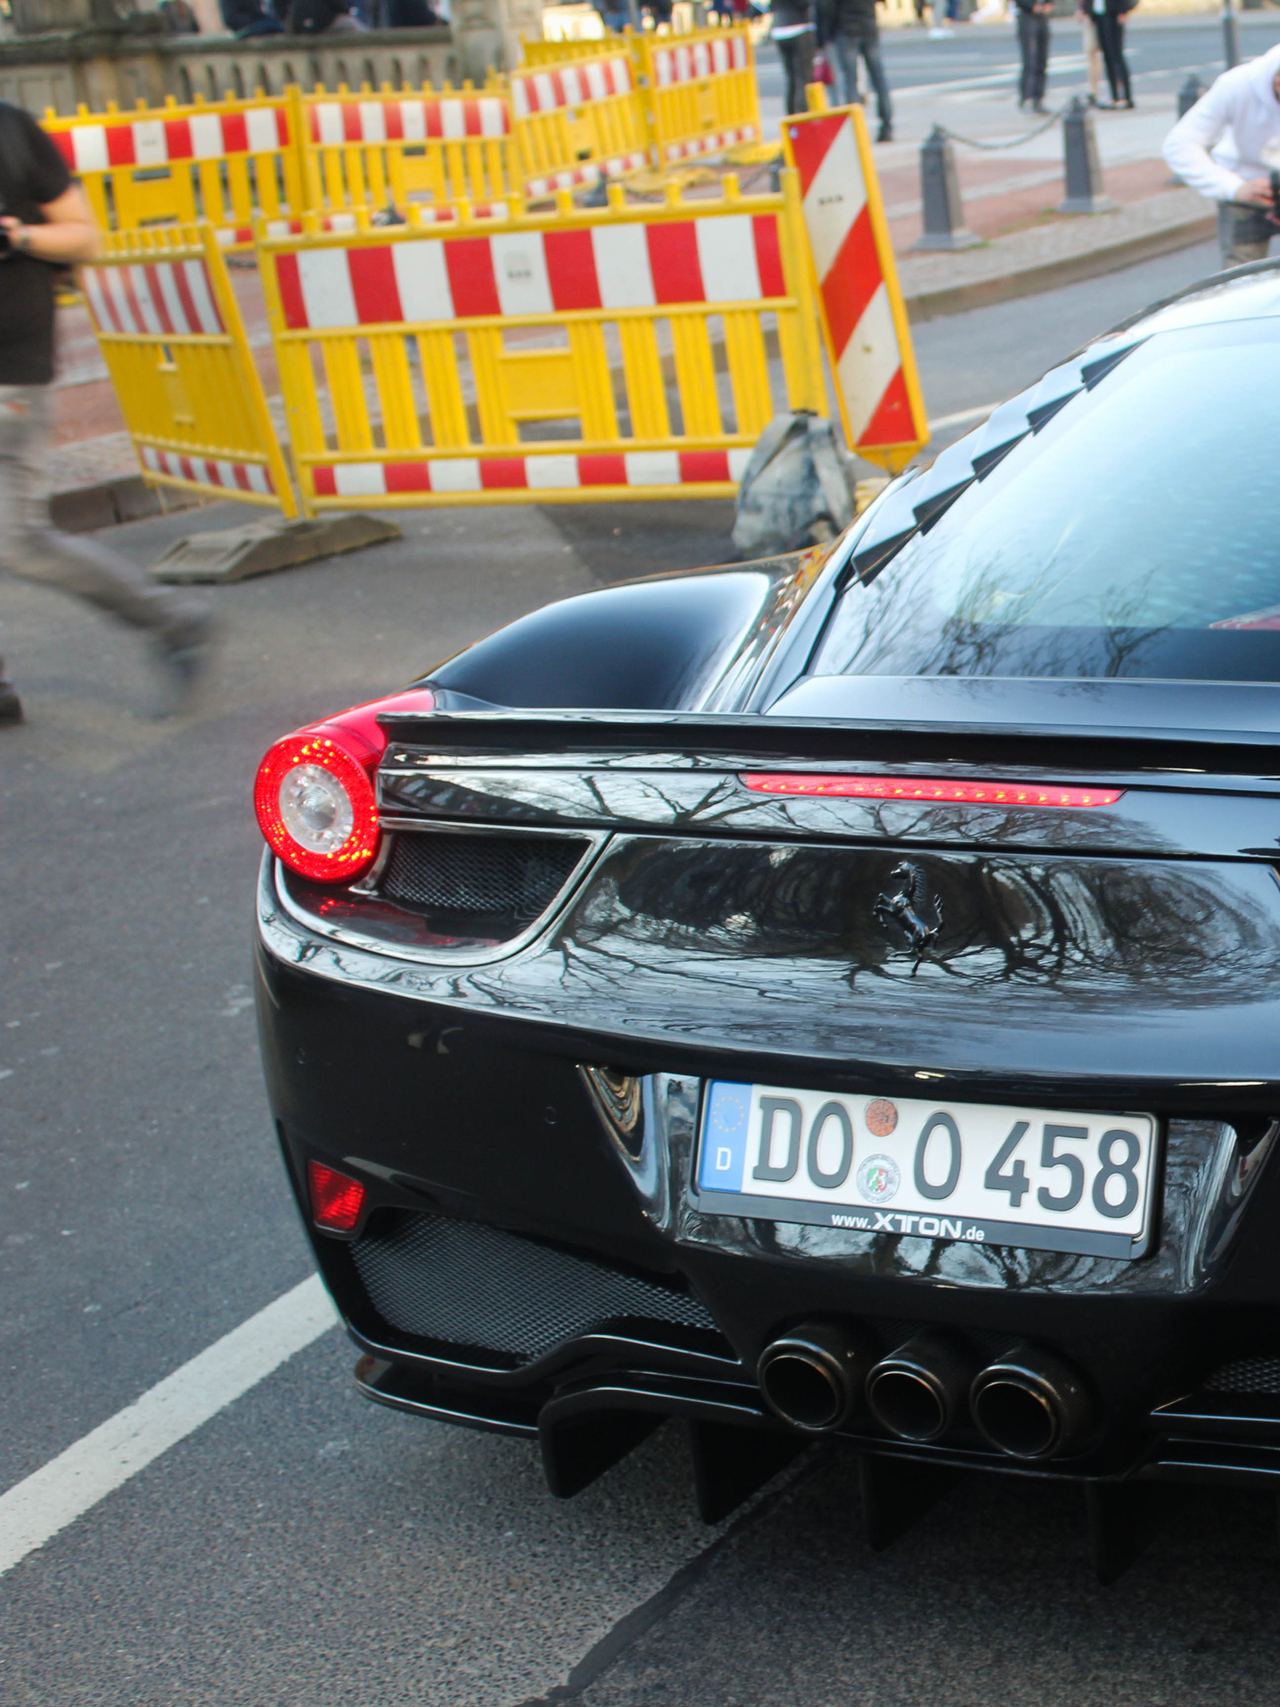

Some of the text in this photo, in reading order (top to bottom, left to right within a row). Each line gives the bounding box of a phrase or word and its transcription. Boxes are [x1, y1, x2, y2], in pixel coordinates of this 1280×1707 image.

[716, 1147, 731, 1170] D
[752, 1096, 1141, 1219] DO O 458
